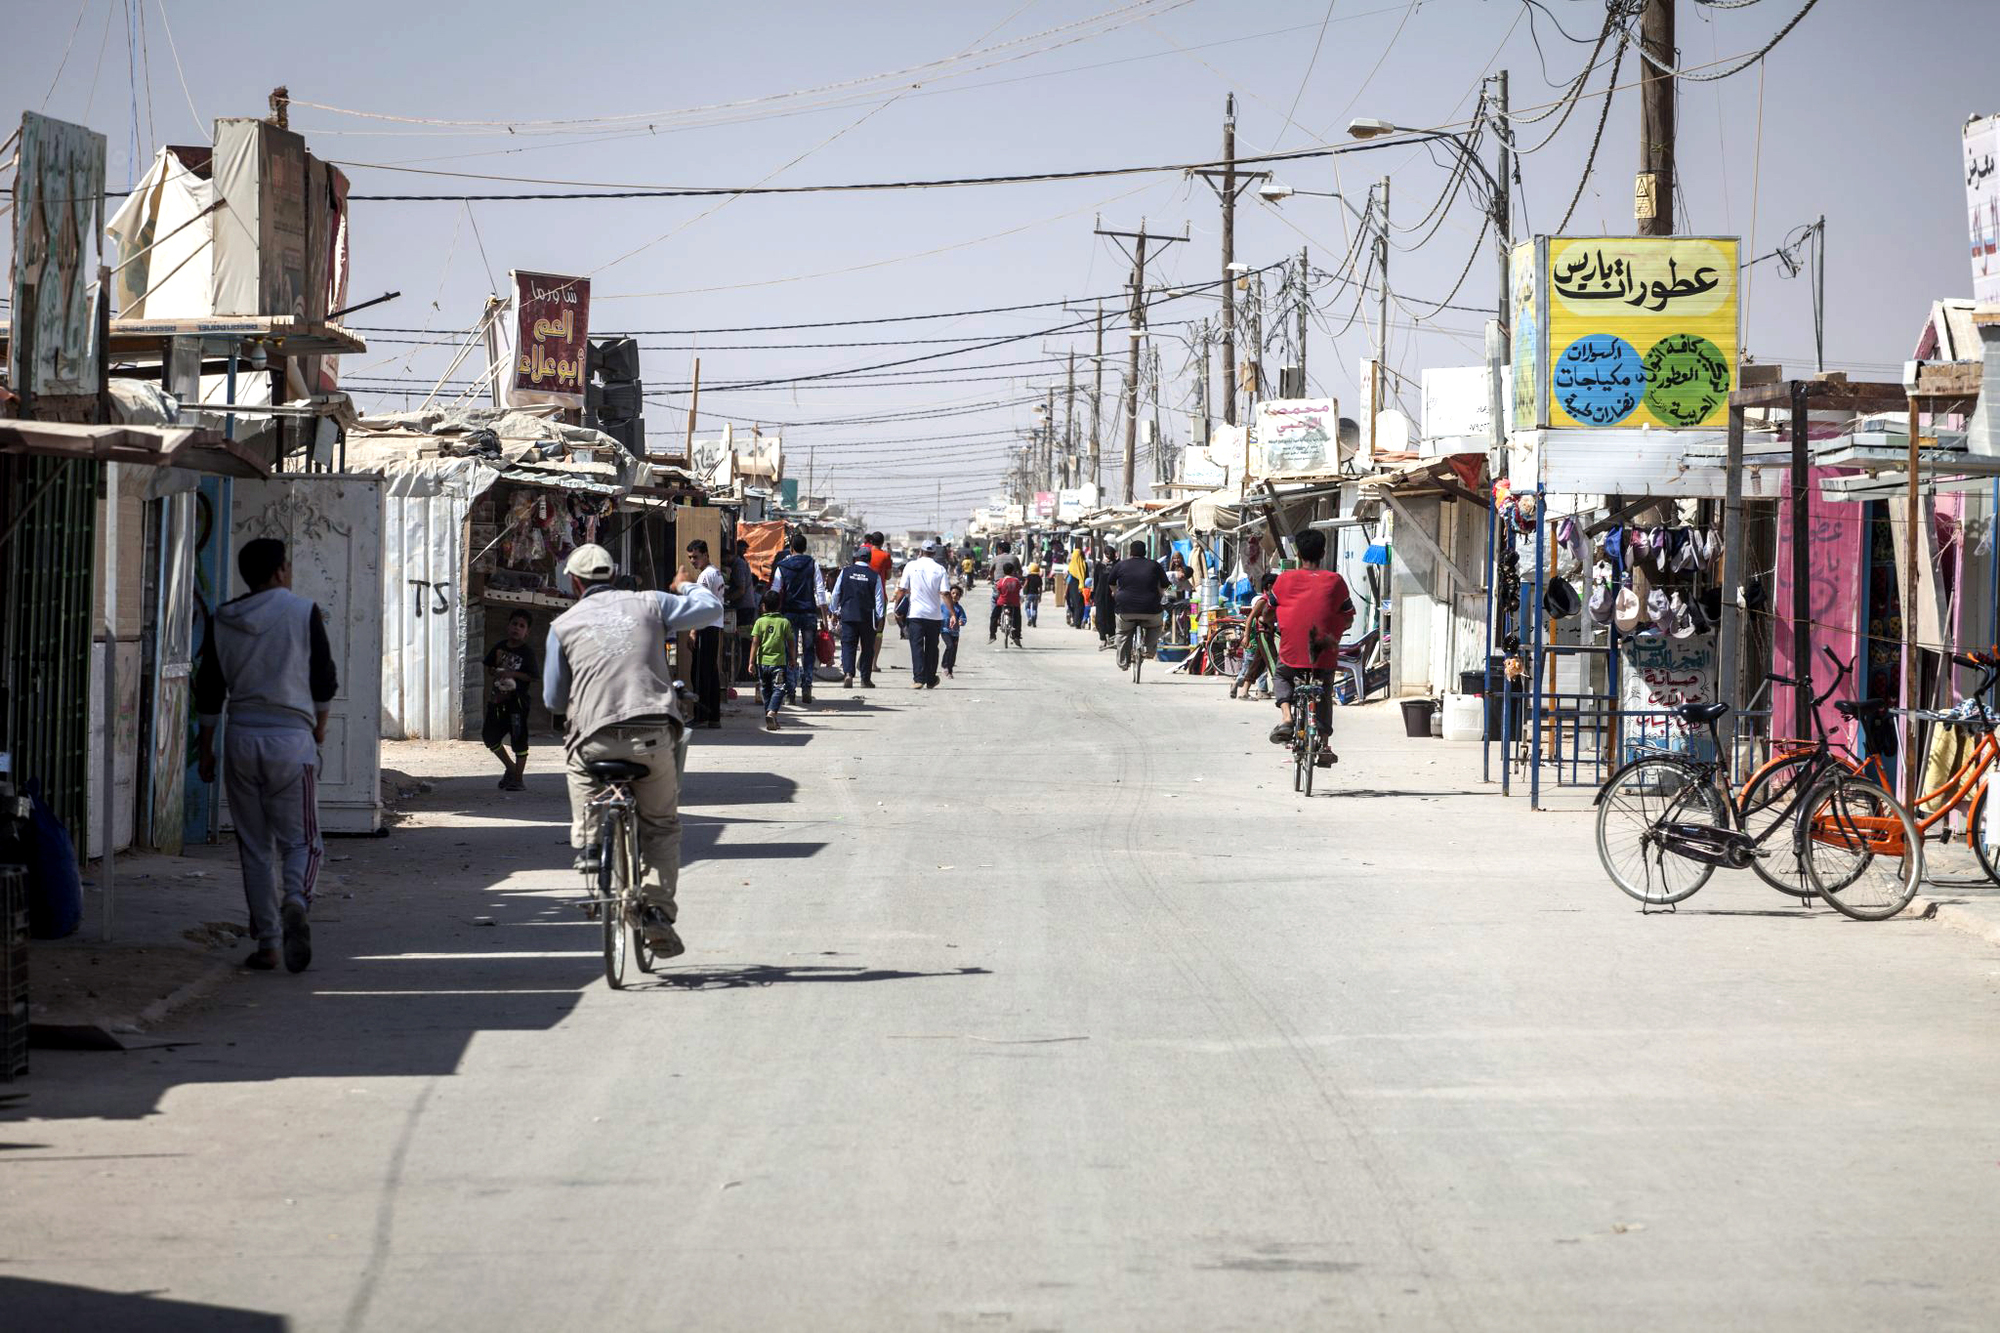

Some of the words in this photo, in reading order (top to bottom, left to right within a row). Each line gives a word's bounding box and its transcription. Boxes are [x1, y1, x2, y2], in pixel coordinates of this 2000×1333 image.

[1553, 249, 1613, 291] باريس
[1554, 256, 1719, 311] عطورات
[1656, 365, 1699, 389] العطور
[1564, 393, 1593, 418] طبية
[1669, 394, 1718, 426] العربية
